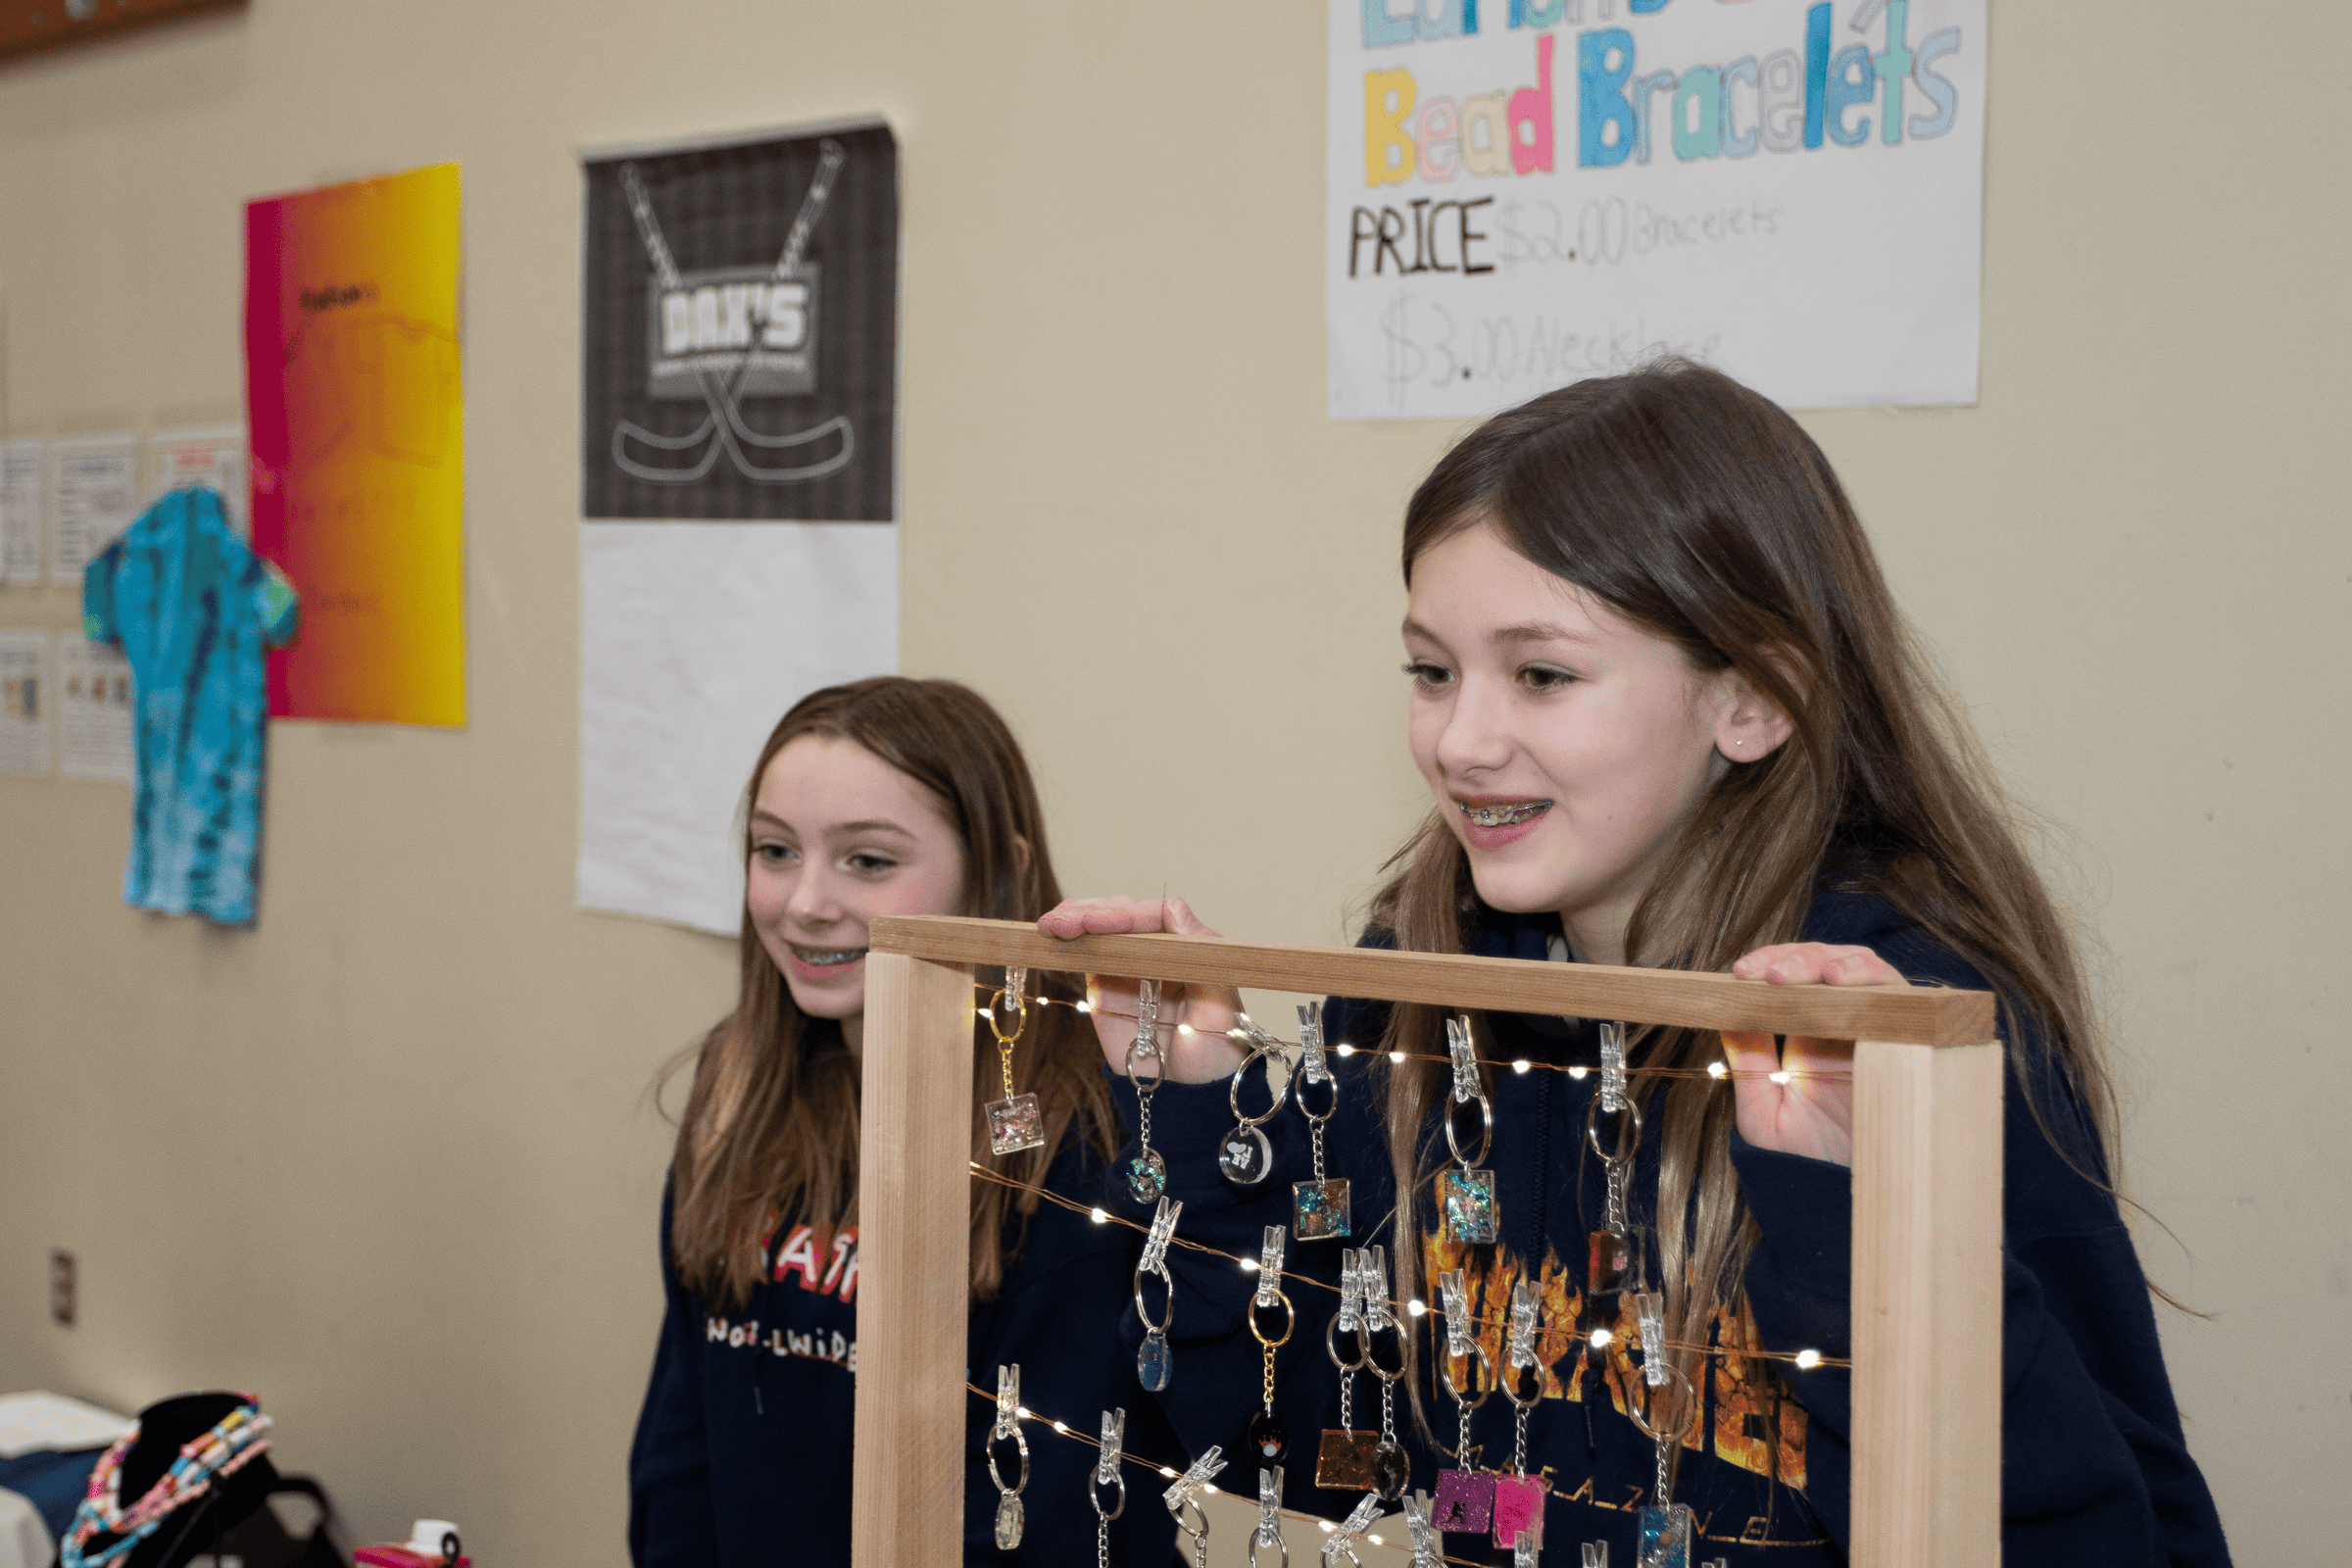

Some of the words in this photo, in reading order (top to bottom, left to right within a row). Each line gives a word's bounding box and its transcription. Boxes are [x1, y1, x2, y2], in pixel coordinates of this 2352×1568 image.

[1362, 33, 1555, 186] Bead
[1577, 0, 1961, 168] Bracelets
[1348, 196, 1494, 278] PRICE
